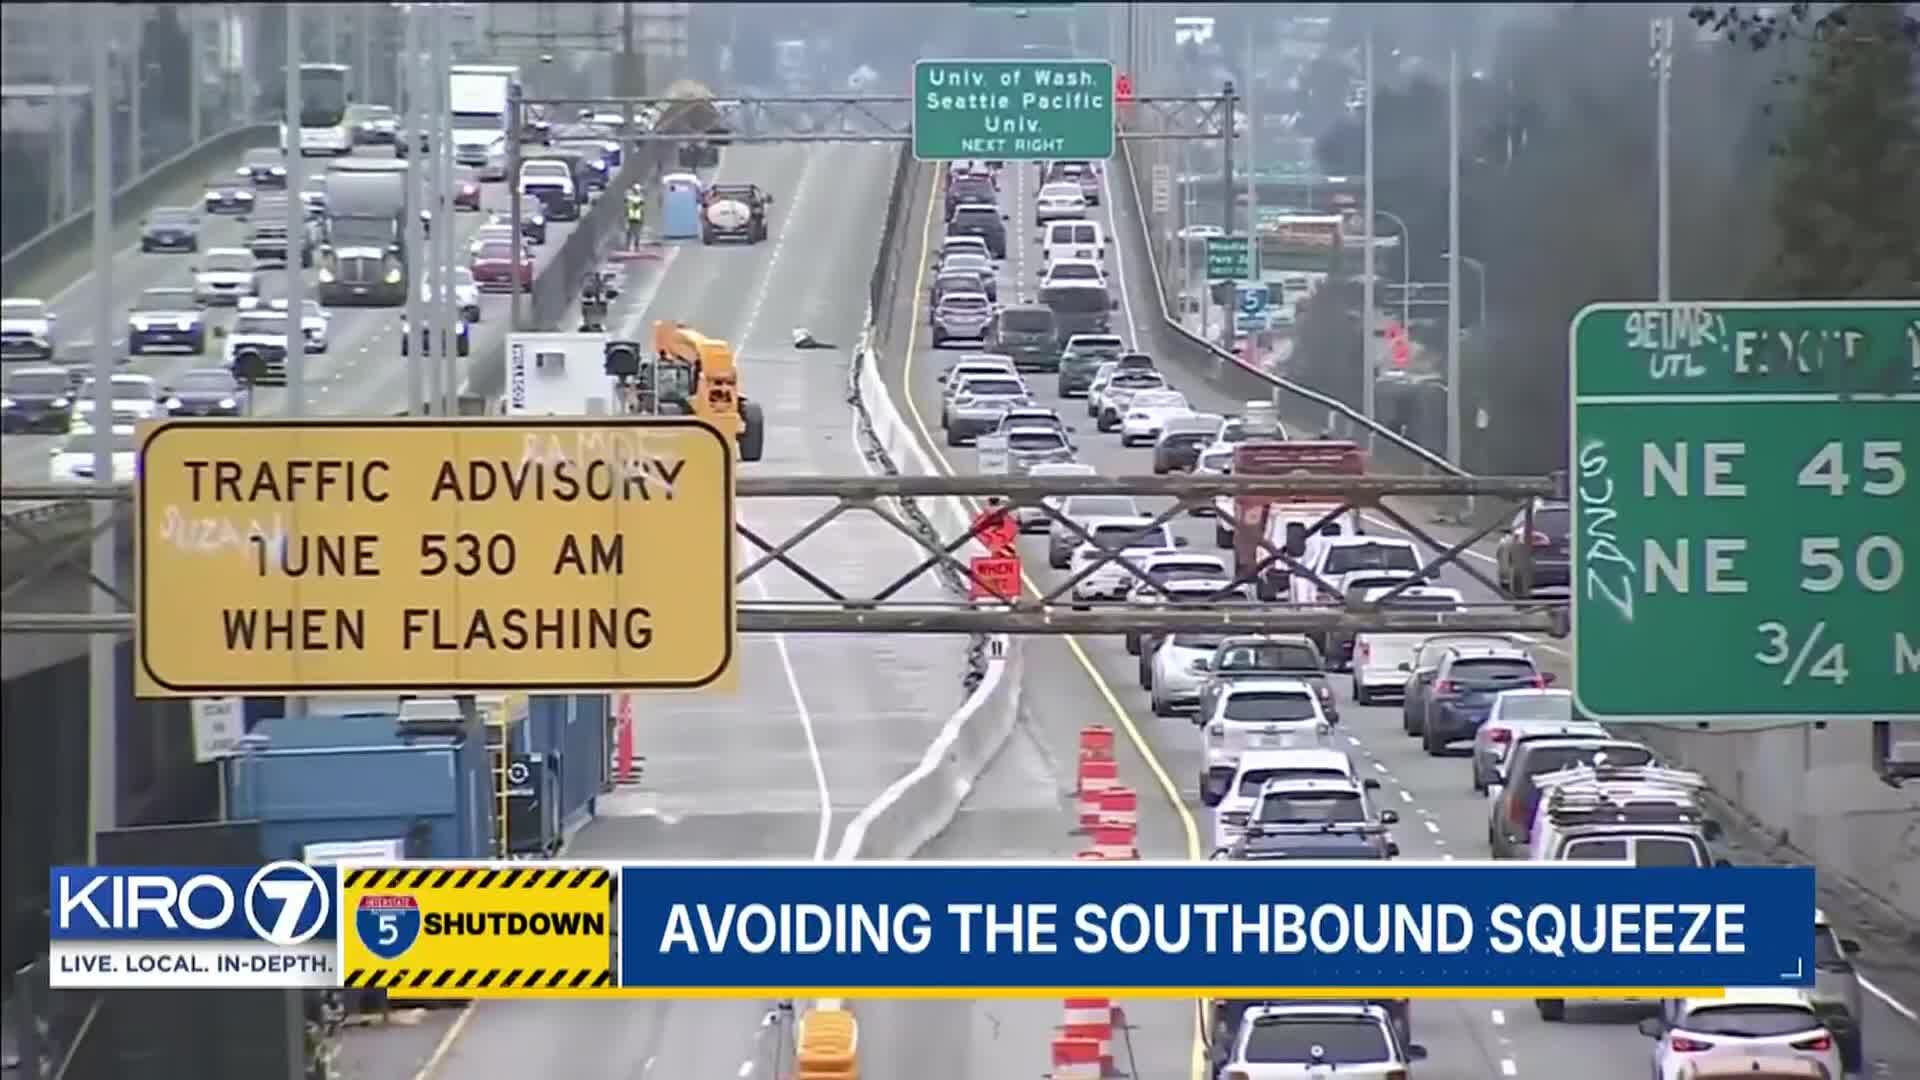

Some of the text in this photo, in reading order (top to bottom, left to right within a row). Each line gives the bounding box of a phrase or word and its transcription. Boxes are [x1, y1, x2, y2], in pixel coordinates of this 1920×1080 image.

[929, 68, 1097, 87] Univ. of Wash.
[926, 92, 1104, 110] Seattle Pacific
[961, 138, 1065, 152] NEXT RIGHT
[984, 115, 1043, 133] Univ.
[183, 459, 686, 503] TRAFFIC ADVISORY
[1642, 441, 1907, 497] NE 45
[420, 533, 517, 577] 530
[553, 533, 625, 576] AM
[1643, 534, 1905, 594] NE 50
[222, 606, 654, 651] WHEN FLASHING
